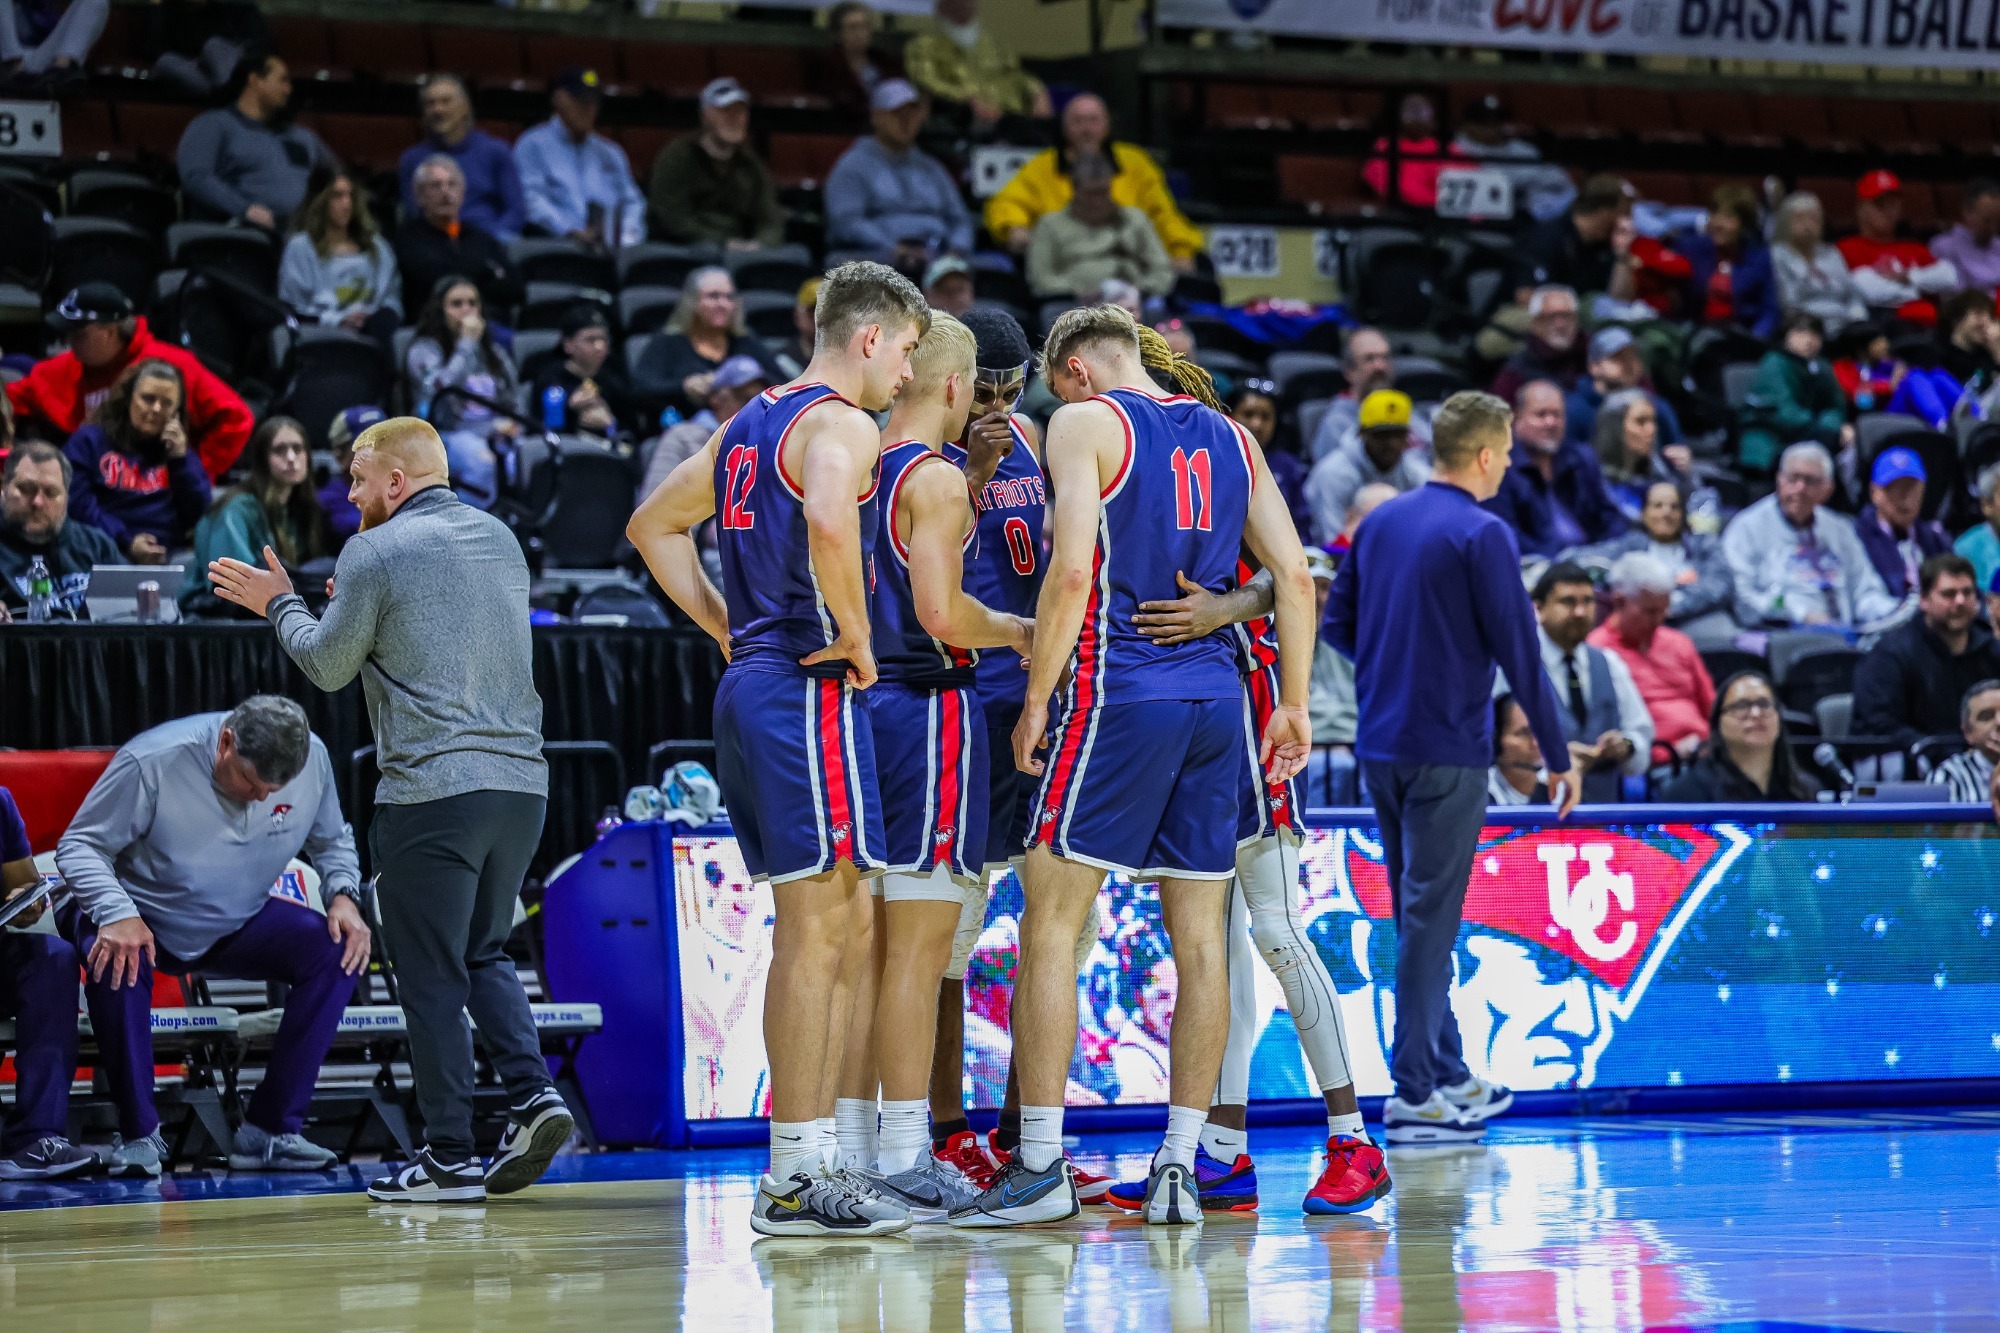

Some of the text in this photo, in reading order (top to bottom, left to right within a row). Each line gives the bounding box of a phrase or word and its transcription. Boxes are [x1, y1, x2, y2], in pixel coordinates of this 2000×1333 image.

[722, 443, 759, 530] 12
[1170, 445, 1213, 531] 11
[1003, 516, 1036, 576] 0
[1536, 842, 1639, 962] UC
